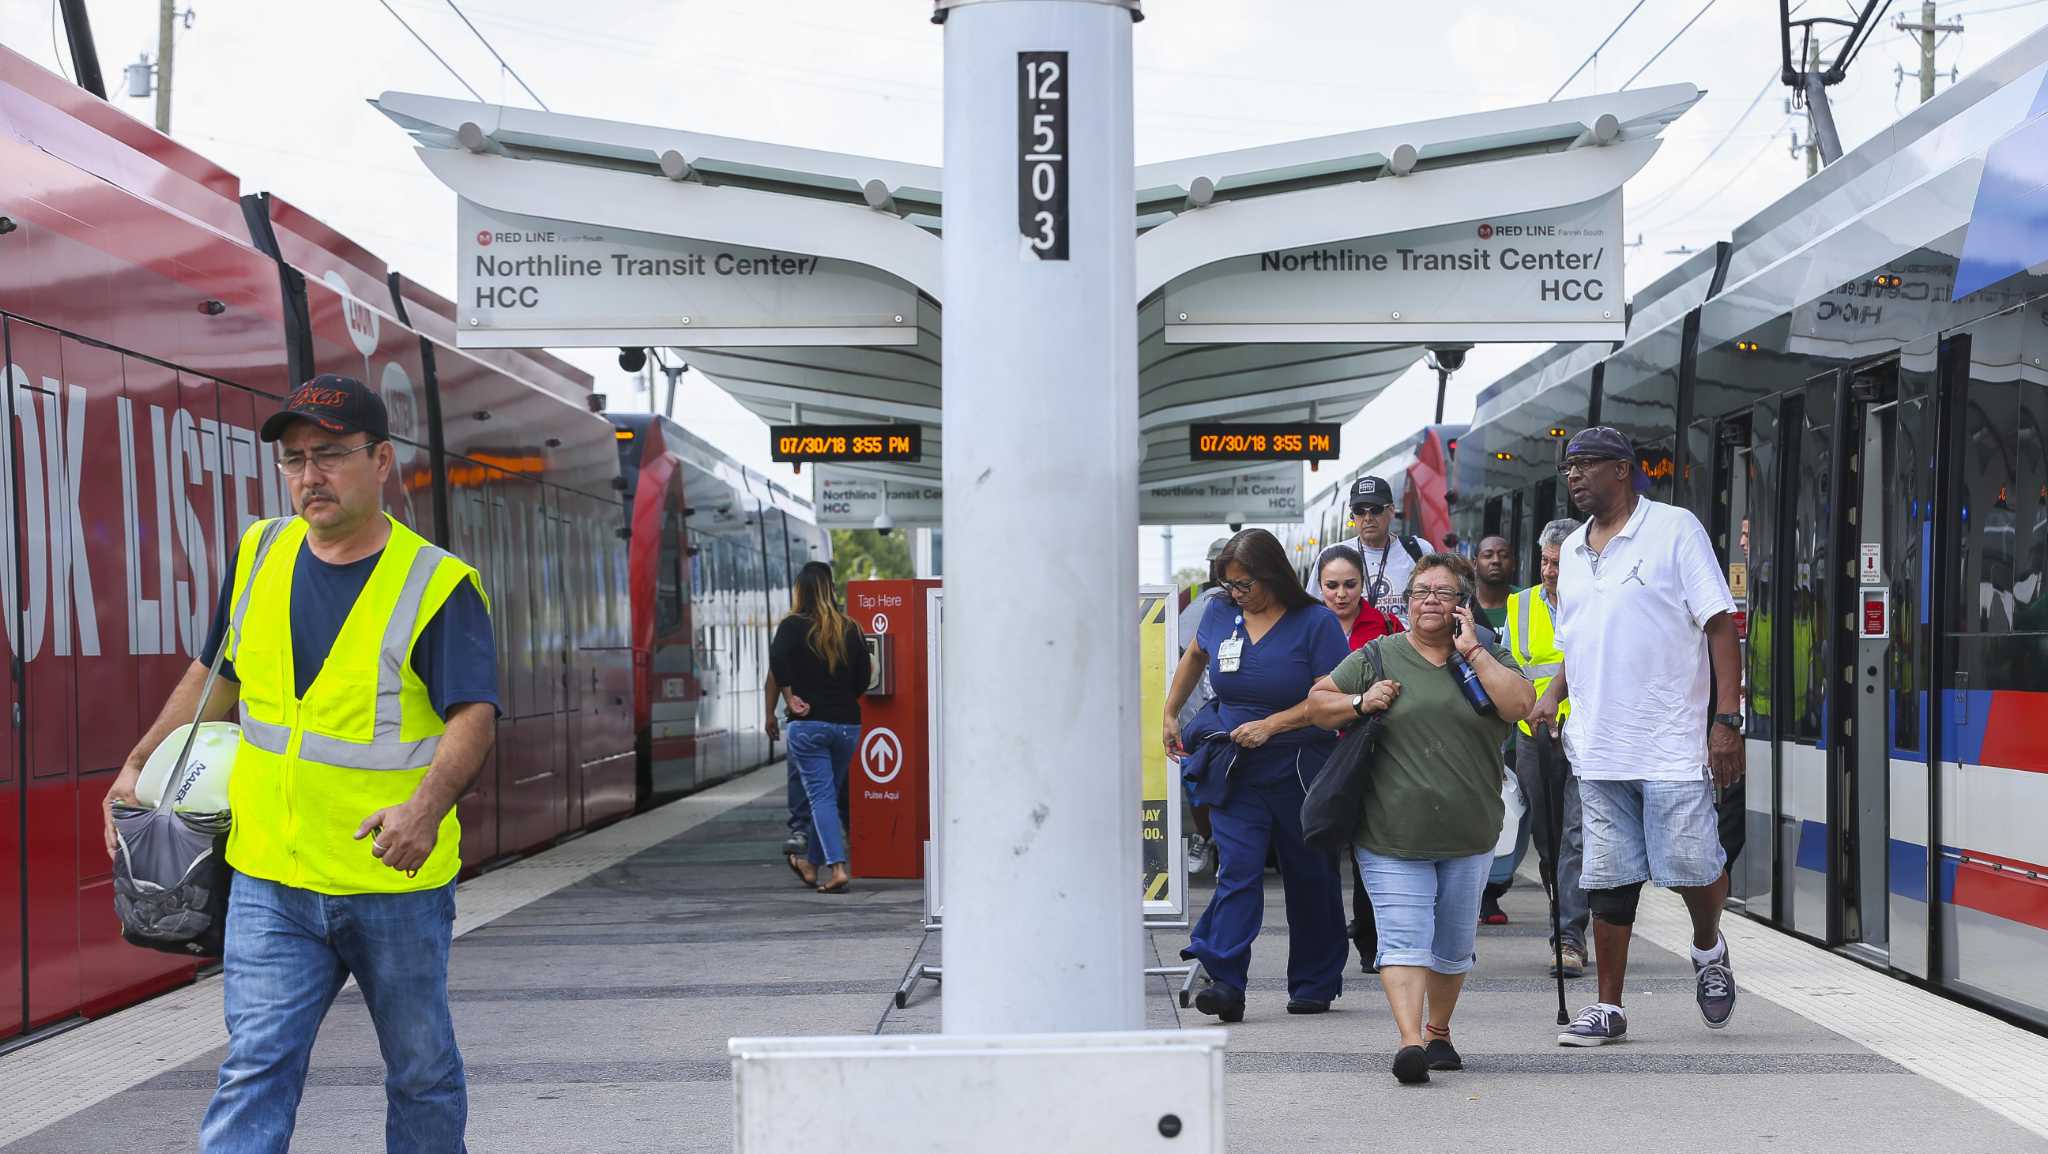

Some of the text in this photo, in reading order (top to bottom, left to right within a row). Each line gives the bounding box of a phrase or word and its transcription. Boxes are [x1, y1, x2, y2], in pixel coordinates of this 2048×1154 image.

[495, 232, 521, 242] RED
[526, 232, 554, 242] LINE
[1496, 226, 1522, 236] RED
[1527, 226, 1555, 236] LINE
[476, 253, 818, 276] Northline Transit Center/
[1261, 247, 1604, 271] Northline Transit Center/
[476, 286, 538, 308] HCC
[1541, 279, 1603, 301] HCC
[780, 437, 909, 453] 07/30/18 3:55 PM
[1200, 435, 1329, 451] 07/30/18 3:55 PM
[823, 491, 876, 499] Northline
[880, 489, 920, 499] ransit
[1210, 485, 1248, 496] Tranit
[1252, 485, 1296, 495] Center/
[823, 505, 850, 513] HCC
[1269, 498, 1296, 508] HCC
[858, 594, 902, 610] Tap Here
[174, 763, 206, 805] MAREK
